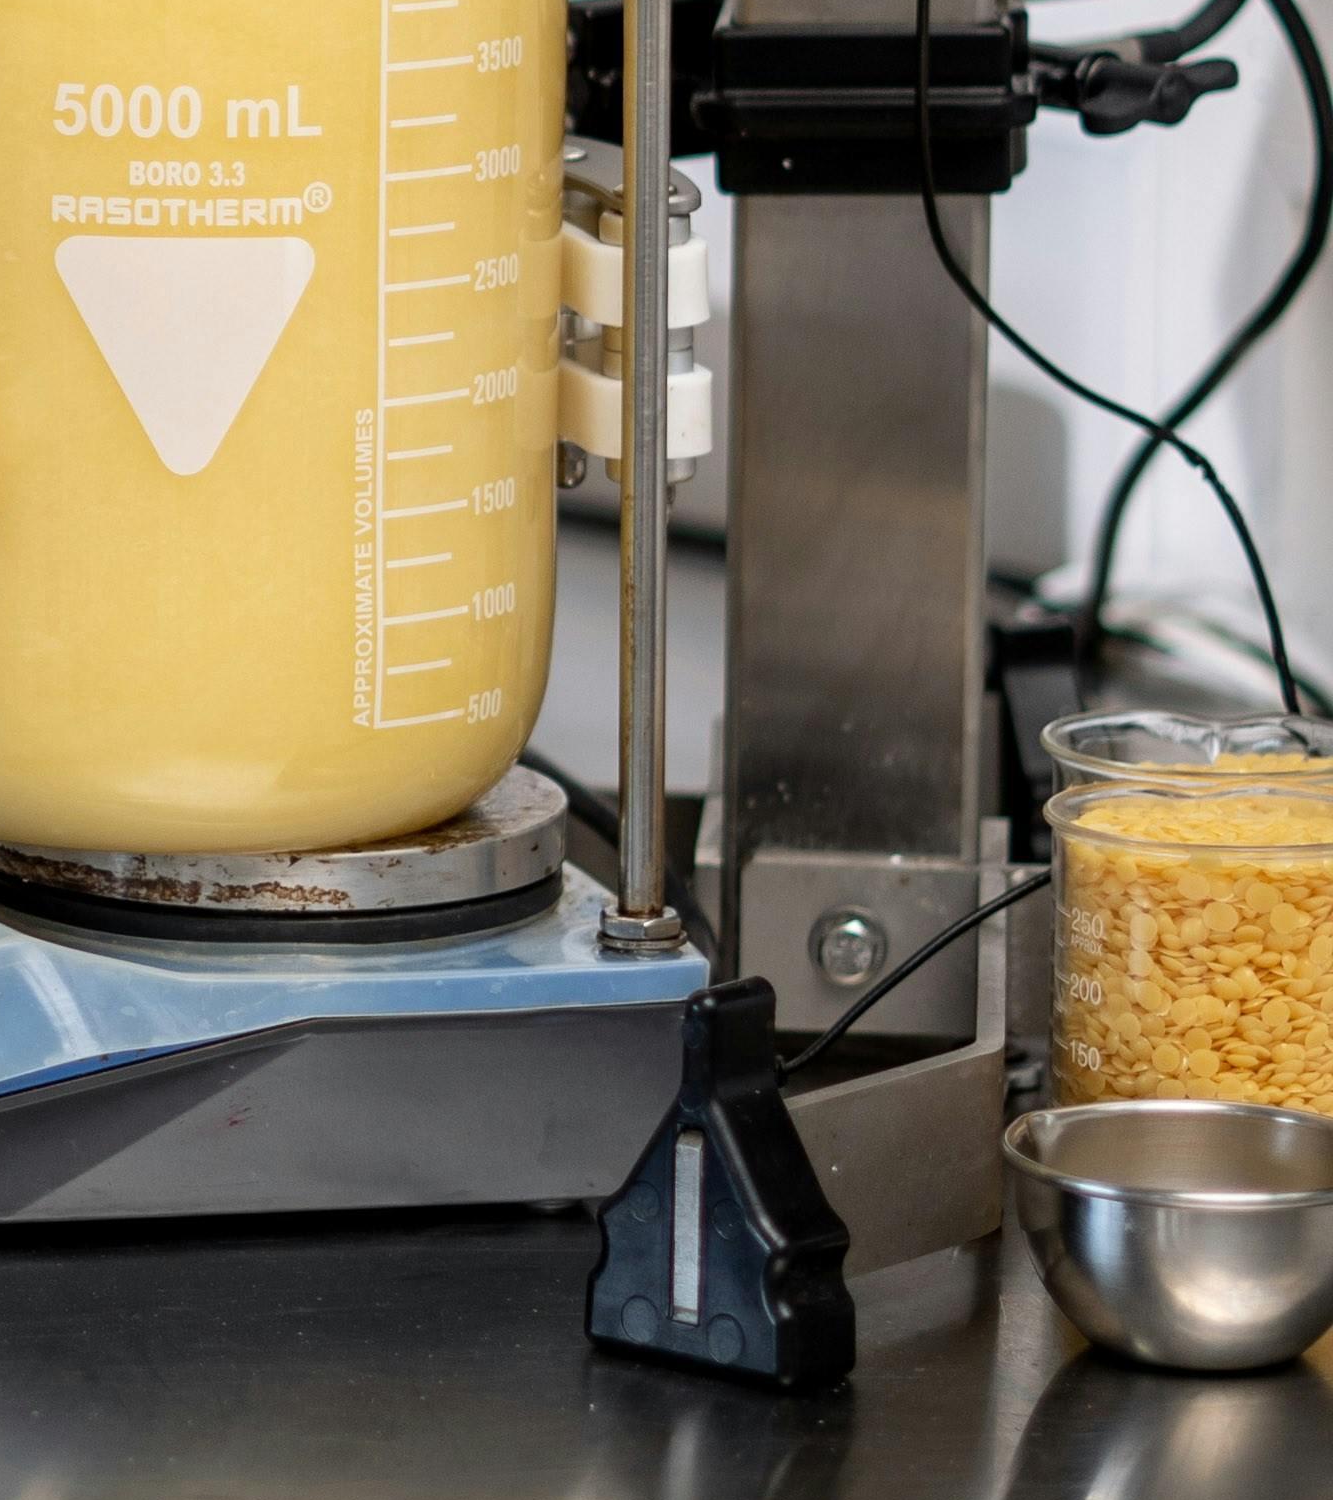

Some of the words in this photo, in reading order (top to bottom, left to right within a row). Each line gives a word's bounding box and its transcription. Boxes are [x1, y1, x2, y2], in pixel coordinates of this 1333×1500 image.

[477, 35, 523, 74] 3500
[53, 83, 202, 139] 5000
[226, 84, 322, 139] mL
[129, 160, 201, 187] BORO
[208, 161, 246, 187] 3.3
[475, 144, 521, 183] 3000
[474, 252, 520, 292] 2500
[472, 365, 518, 406] 2000
[354, 407, 374, 537] VOLUMES
[471, 476, 516, 516] 1500
[471, 581, 516, 622] 1000
[352, 539, 373, 728] APPROXIMATE
[466, 687, 502, 725] 500
[1071, 906, 1104, 940] 250
[1070, 934, 1103, 957] APPROX
[1069, 972, 1102, 1006] 200
[1069, 1039, 1101, 1072] 150
